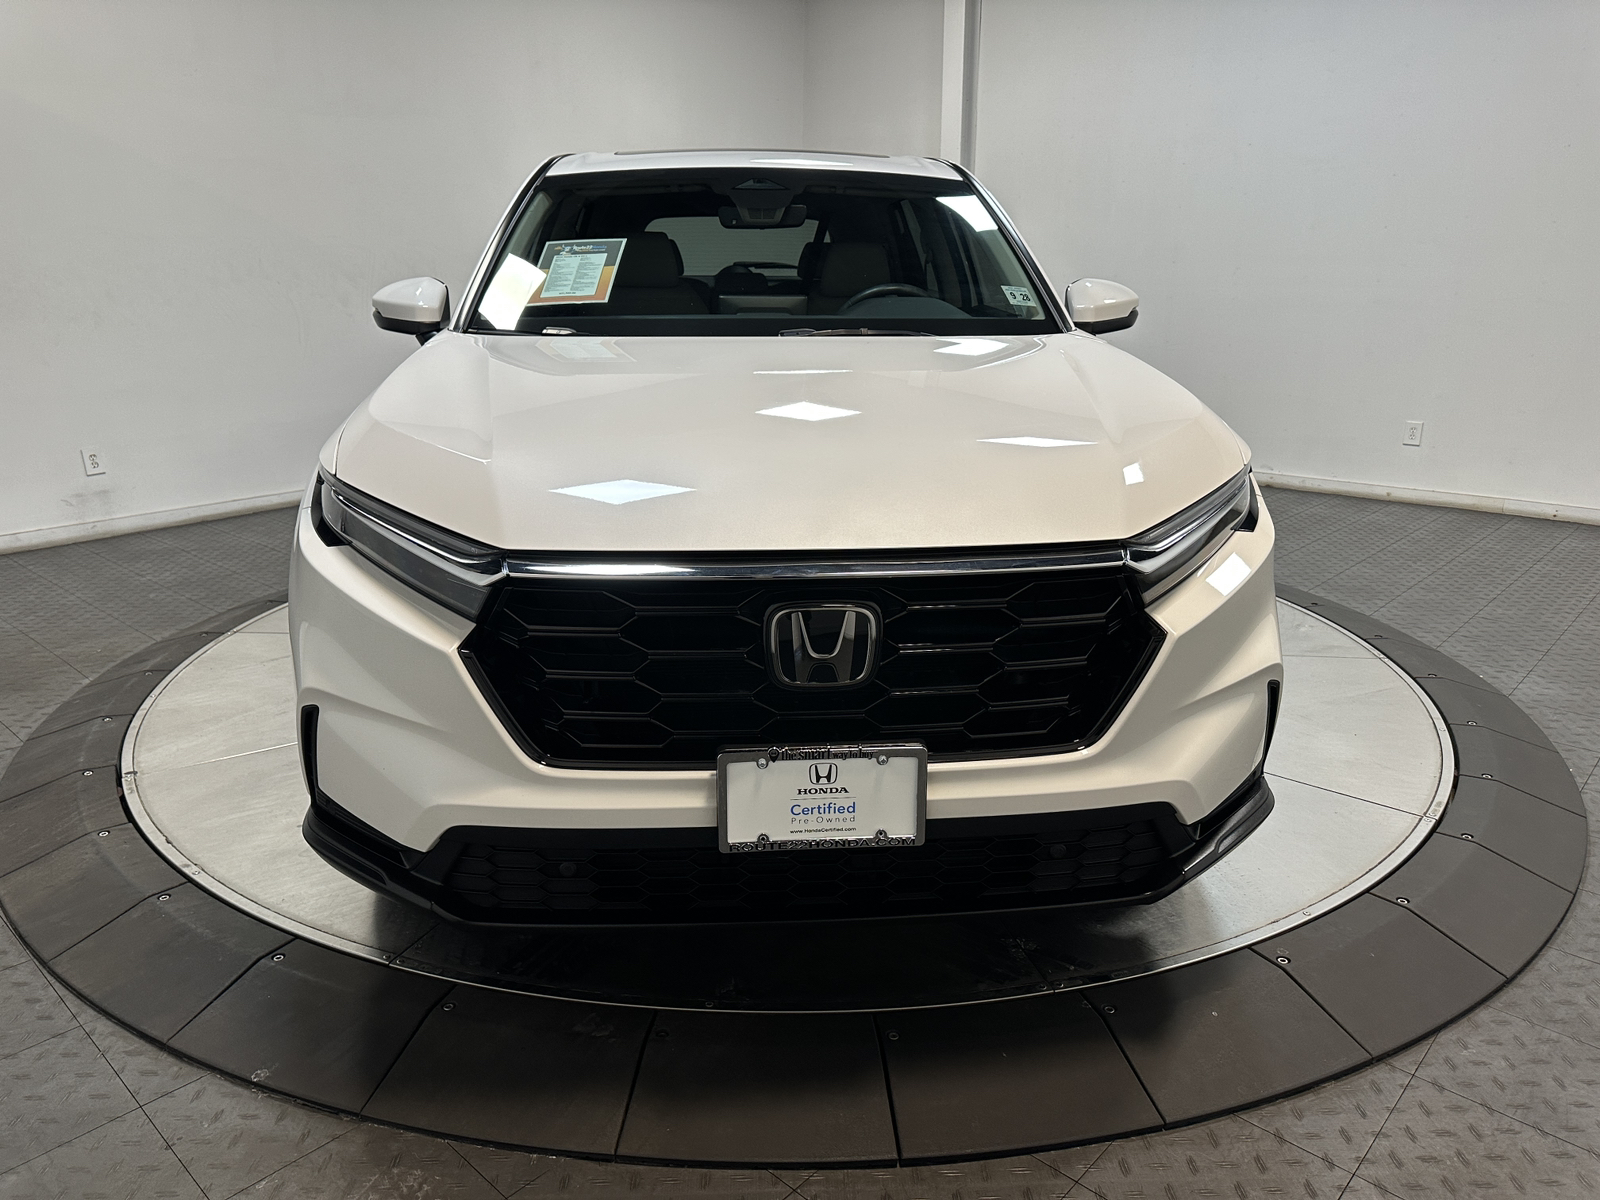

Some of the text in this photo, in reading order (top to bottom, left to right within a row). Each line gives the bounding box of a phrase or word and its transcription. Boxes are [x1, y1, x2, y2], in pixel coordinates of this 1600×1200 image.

[1019, 293, 1031, 301] 28
[798, 747, 831, 760] smart
[833, 750, 848, 760] way
[859, 746, 874, 760] buy
[797, 787, 850, 796] HONDA
[790, 801, 856, 816] Certified
[791, 815, 855, 824] Pre-Owned
[728, 837, 916, 853] ROUTE22HONDA.COM
